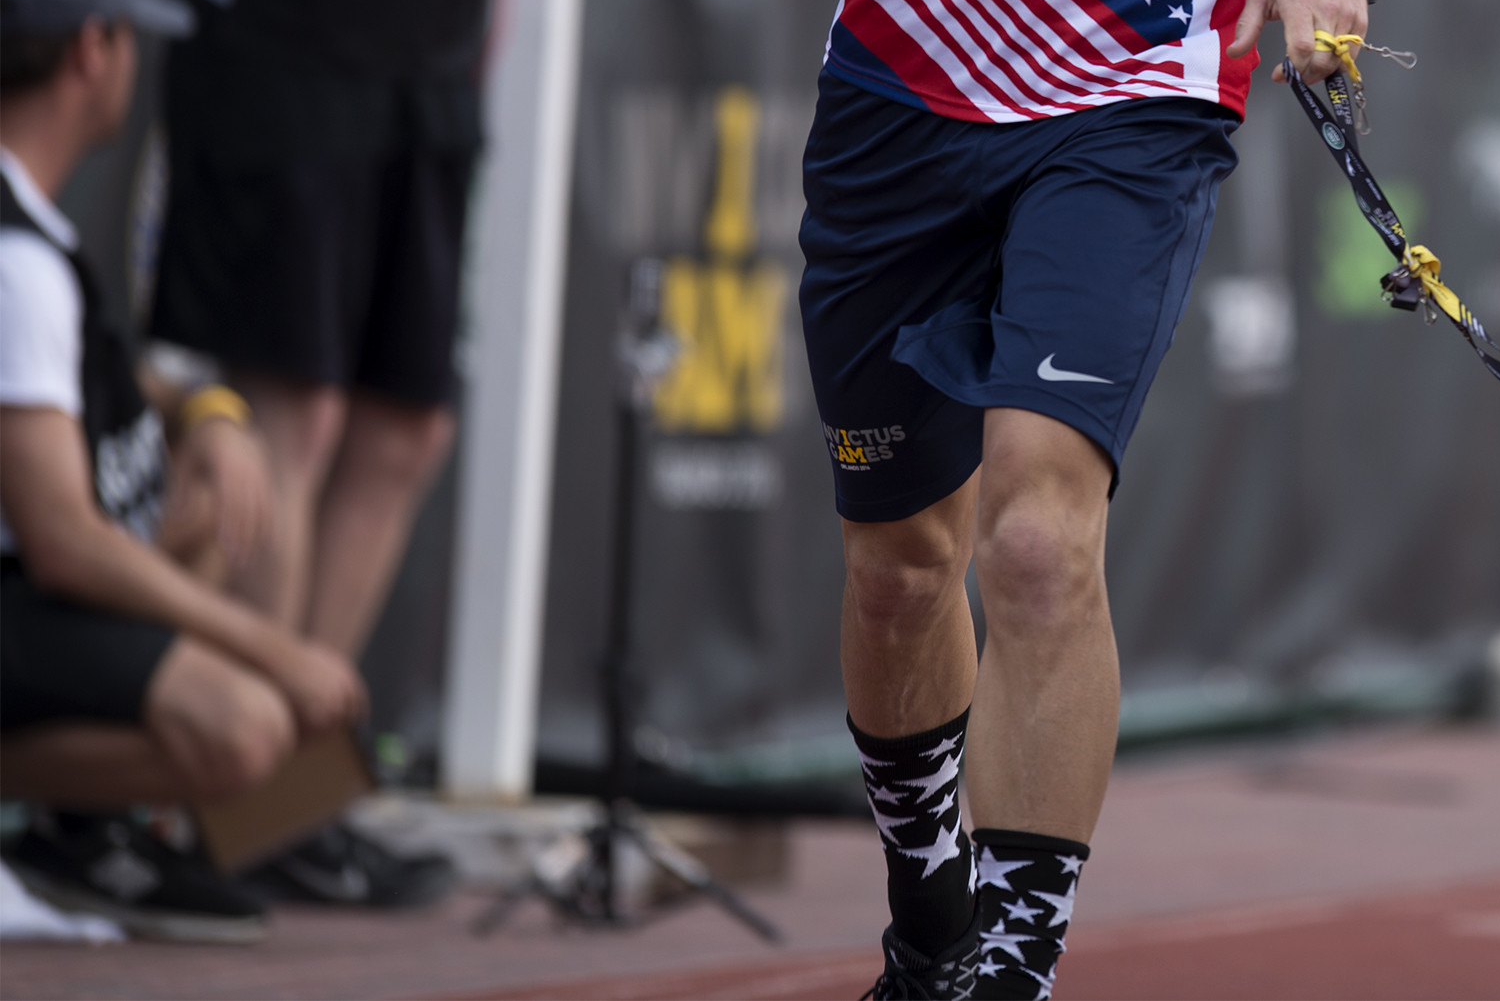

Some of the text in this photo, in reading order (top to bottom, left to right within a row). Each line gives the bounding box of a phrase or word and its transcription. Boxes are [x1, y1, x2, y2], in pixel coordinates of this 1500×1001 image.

[1327, 82, 1346, 116] GAMES
[1335, 77, 1353, 125] INVICTUS
[829, 441, 894, 464] GAMES
